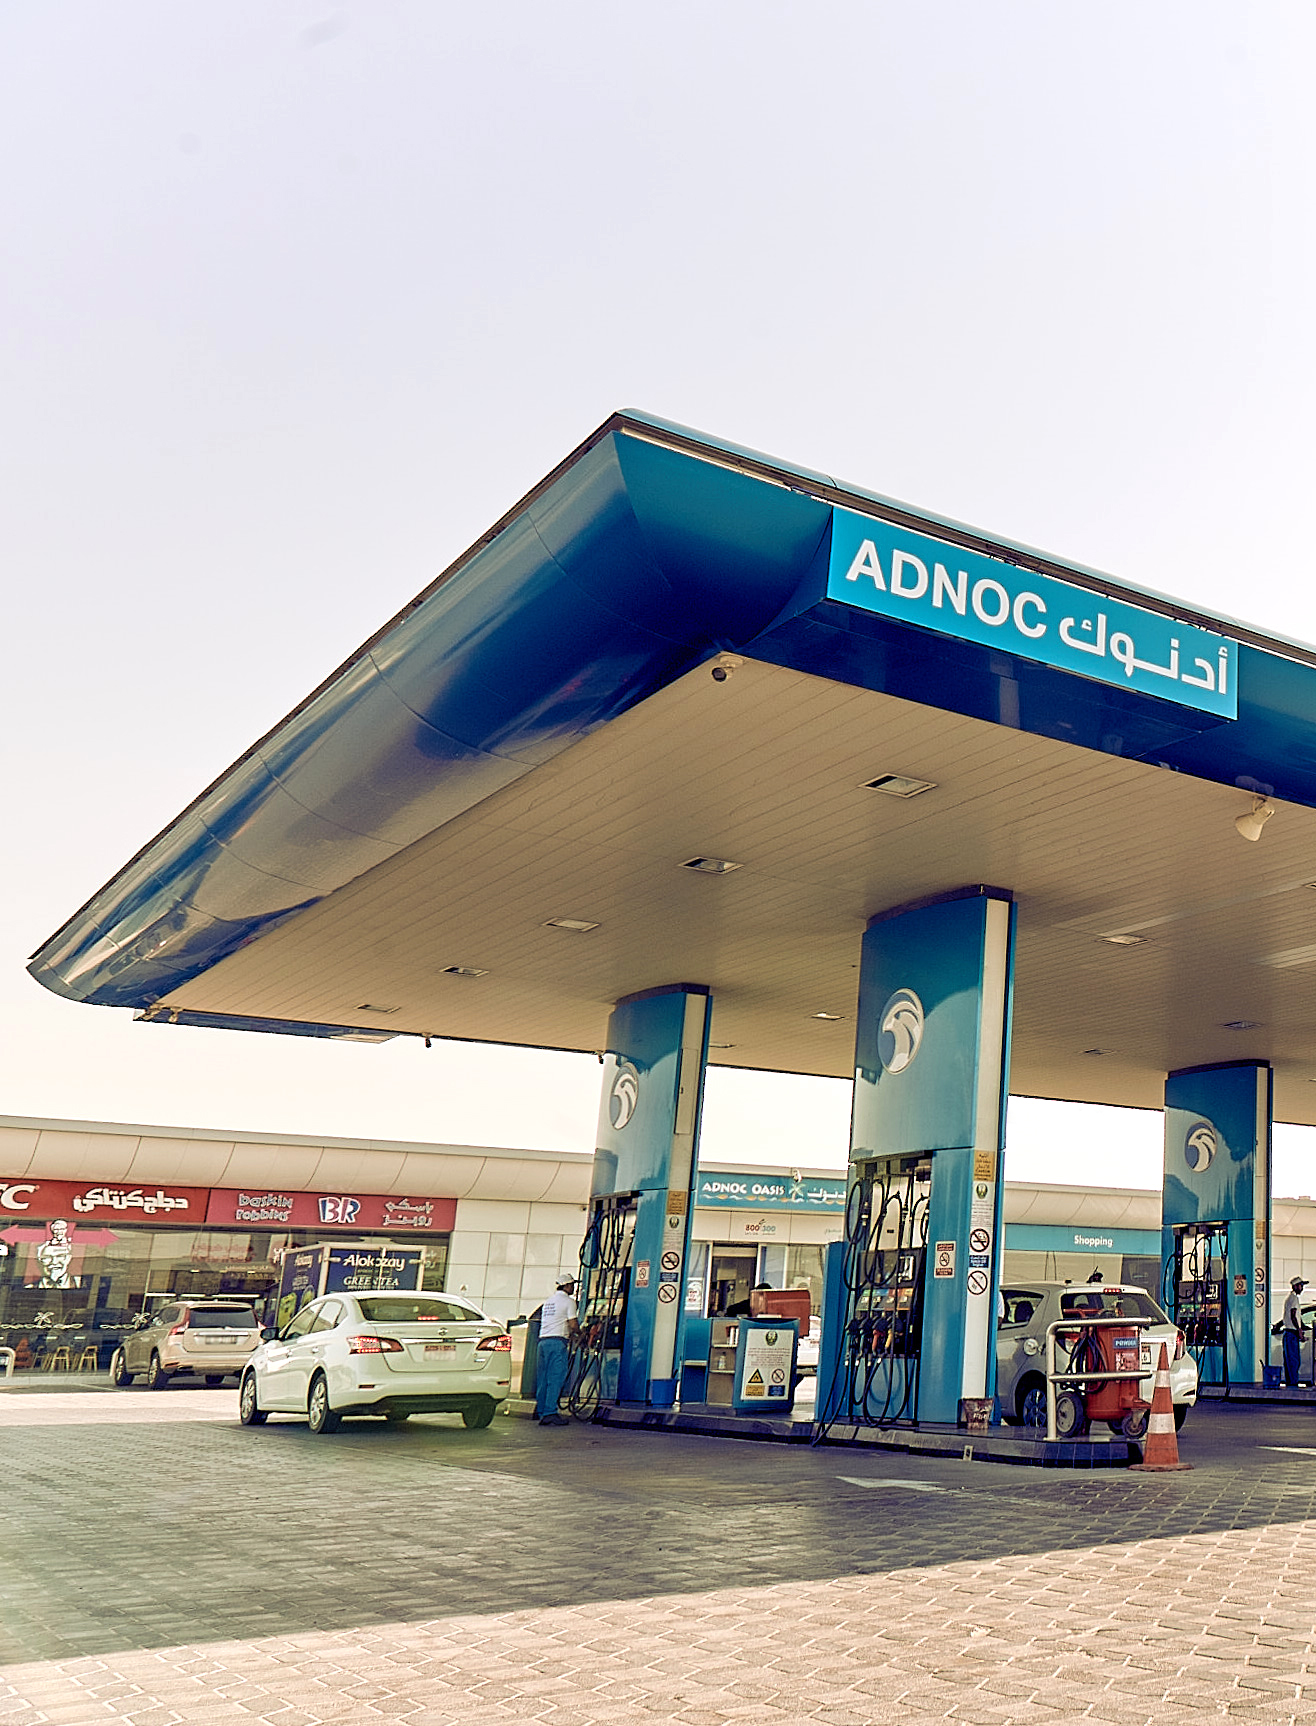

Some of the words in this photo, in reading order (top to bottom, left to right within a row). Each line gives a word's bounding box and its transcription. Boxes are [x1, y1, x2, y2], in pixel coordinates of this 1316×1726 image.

[845, 539, 1048, 639] ADNOC
[1058, 613, 1229, 695] أدنوك
[702, 1182, 747, 1194] ADNOC
[751, 1184, 785, 1196] OASIS
[73, 1187, 144, 1213] كنتاكي
[143, 1190, 189, 1214] دجاج
[318, 1196, 361, 1224] BR
[745, 1224, 760, 1232] 800
[1074, 1234, 1114, 1249] Shopping
[342, 1254, 406, 1272] Alokozay
[380, 1276, 400, 1287] TEA
